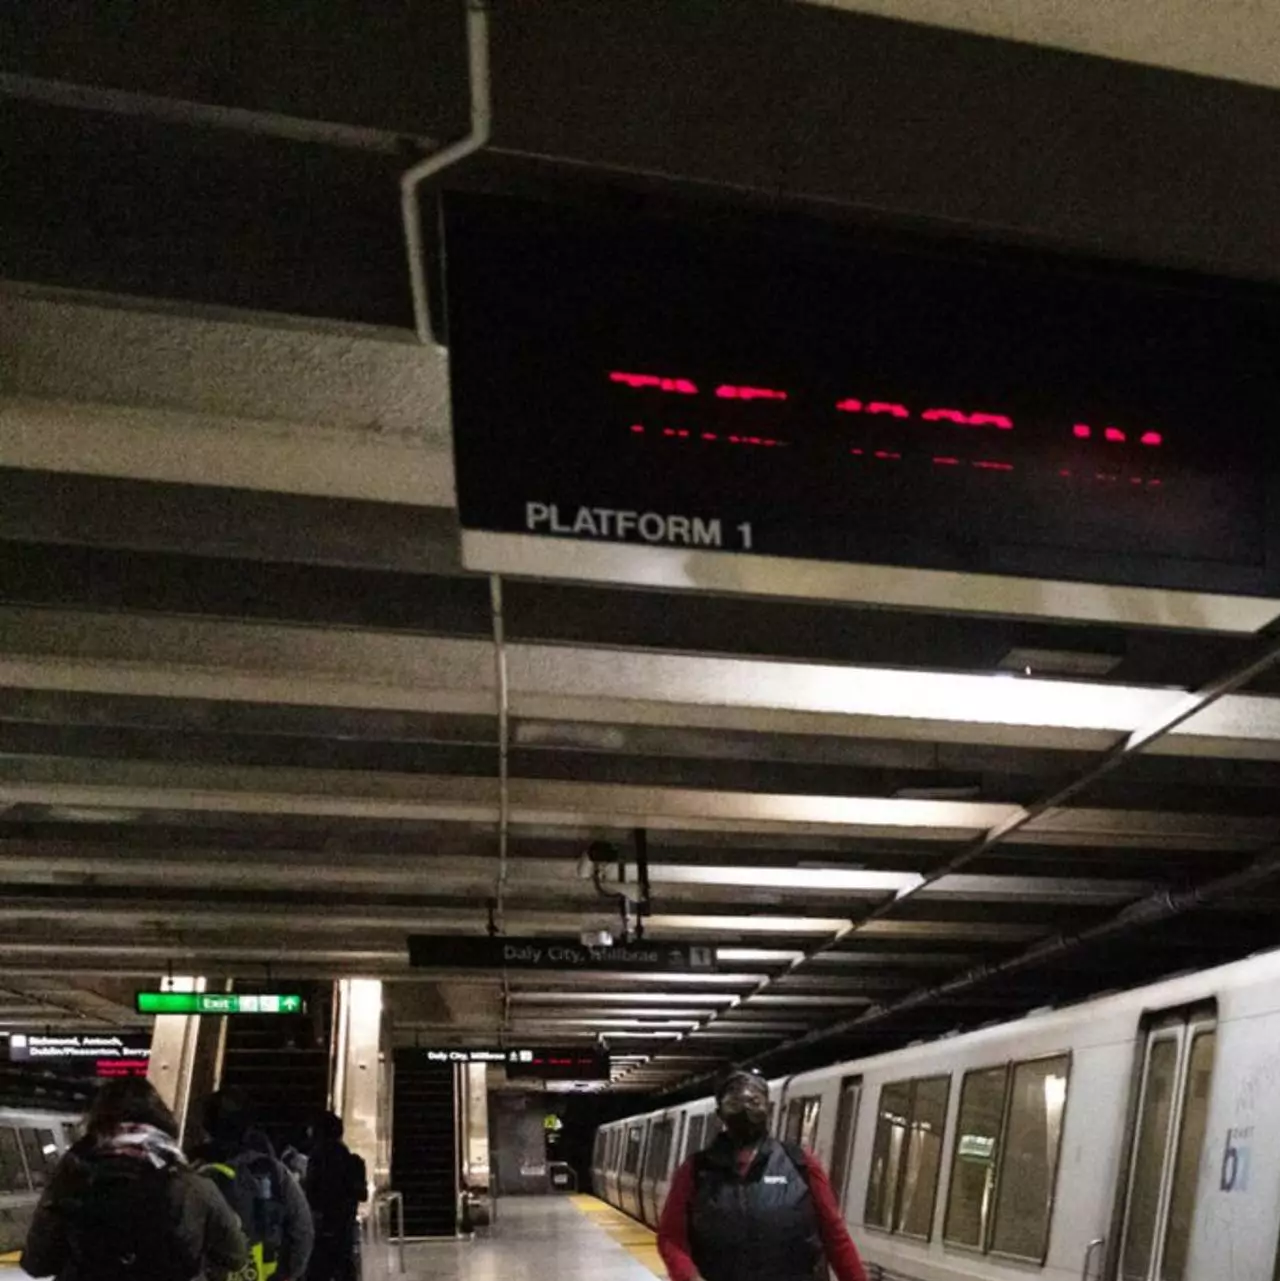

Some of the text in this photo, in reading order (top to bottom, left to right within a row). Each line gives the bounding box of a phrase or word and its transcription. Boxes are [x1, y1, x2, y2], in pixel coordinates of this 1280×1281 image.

[526, 501, 751, 548] PLATFORM 1
[503, 944, 542, 963] Daly
[203, 997, 230, 1009] Exit
